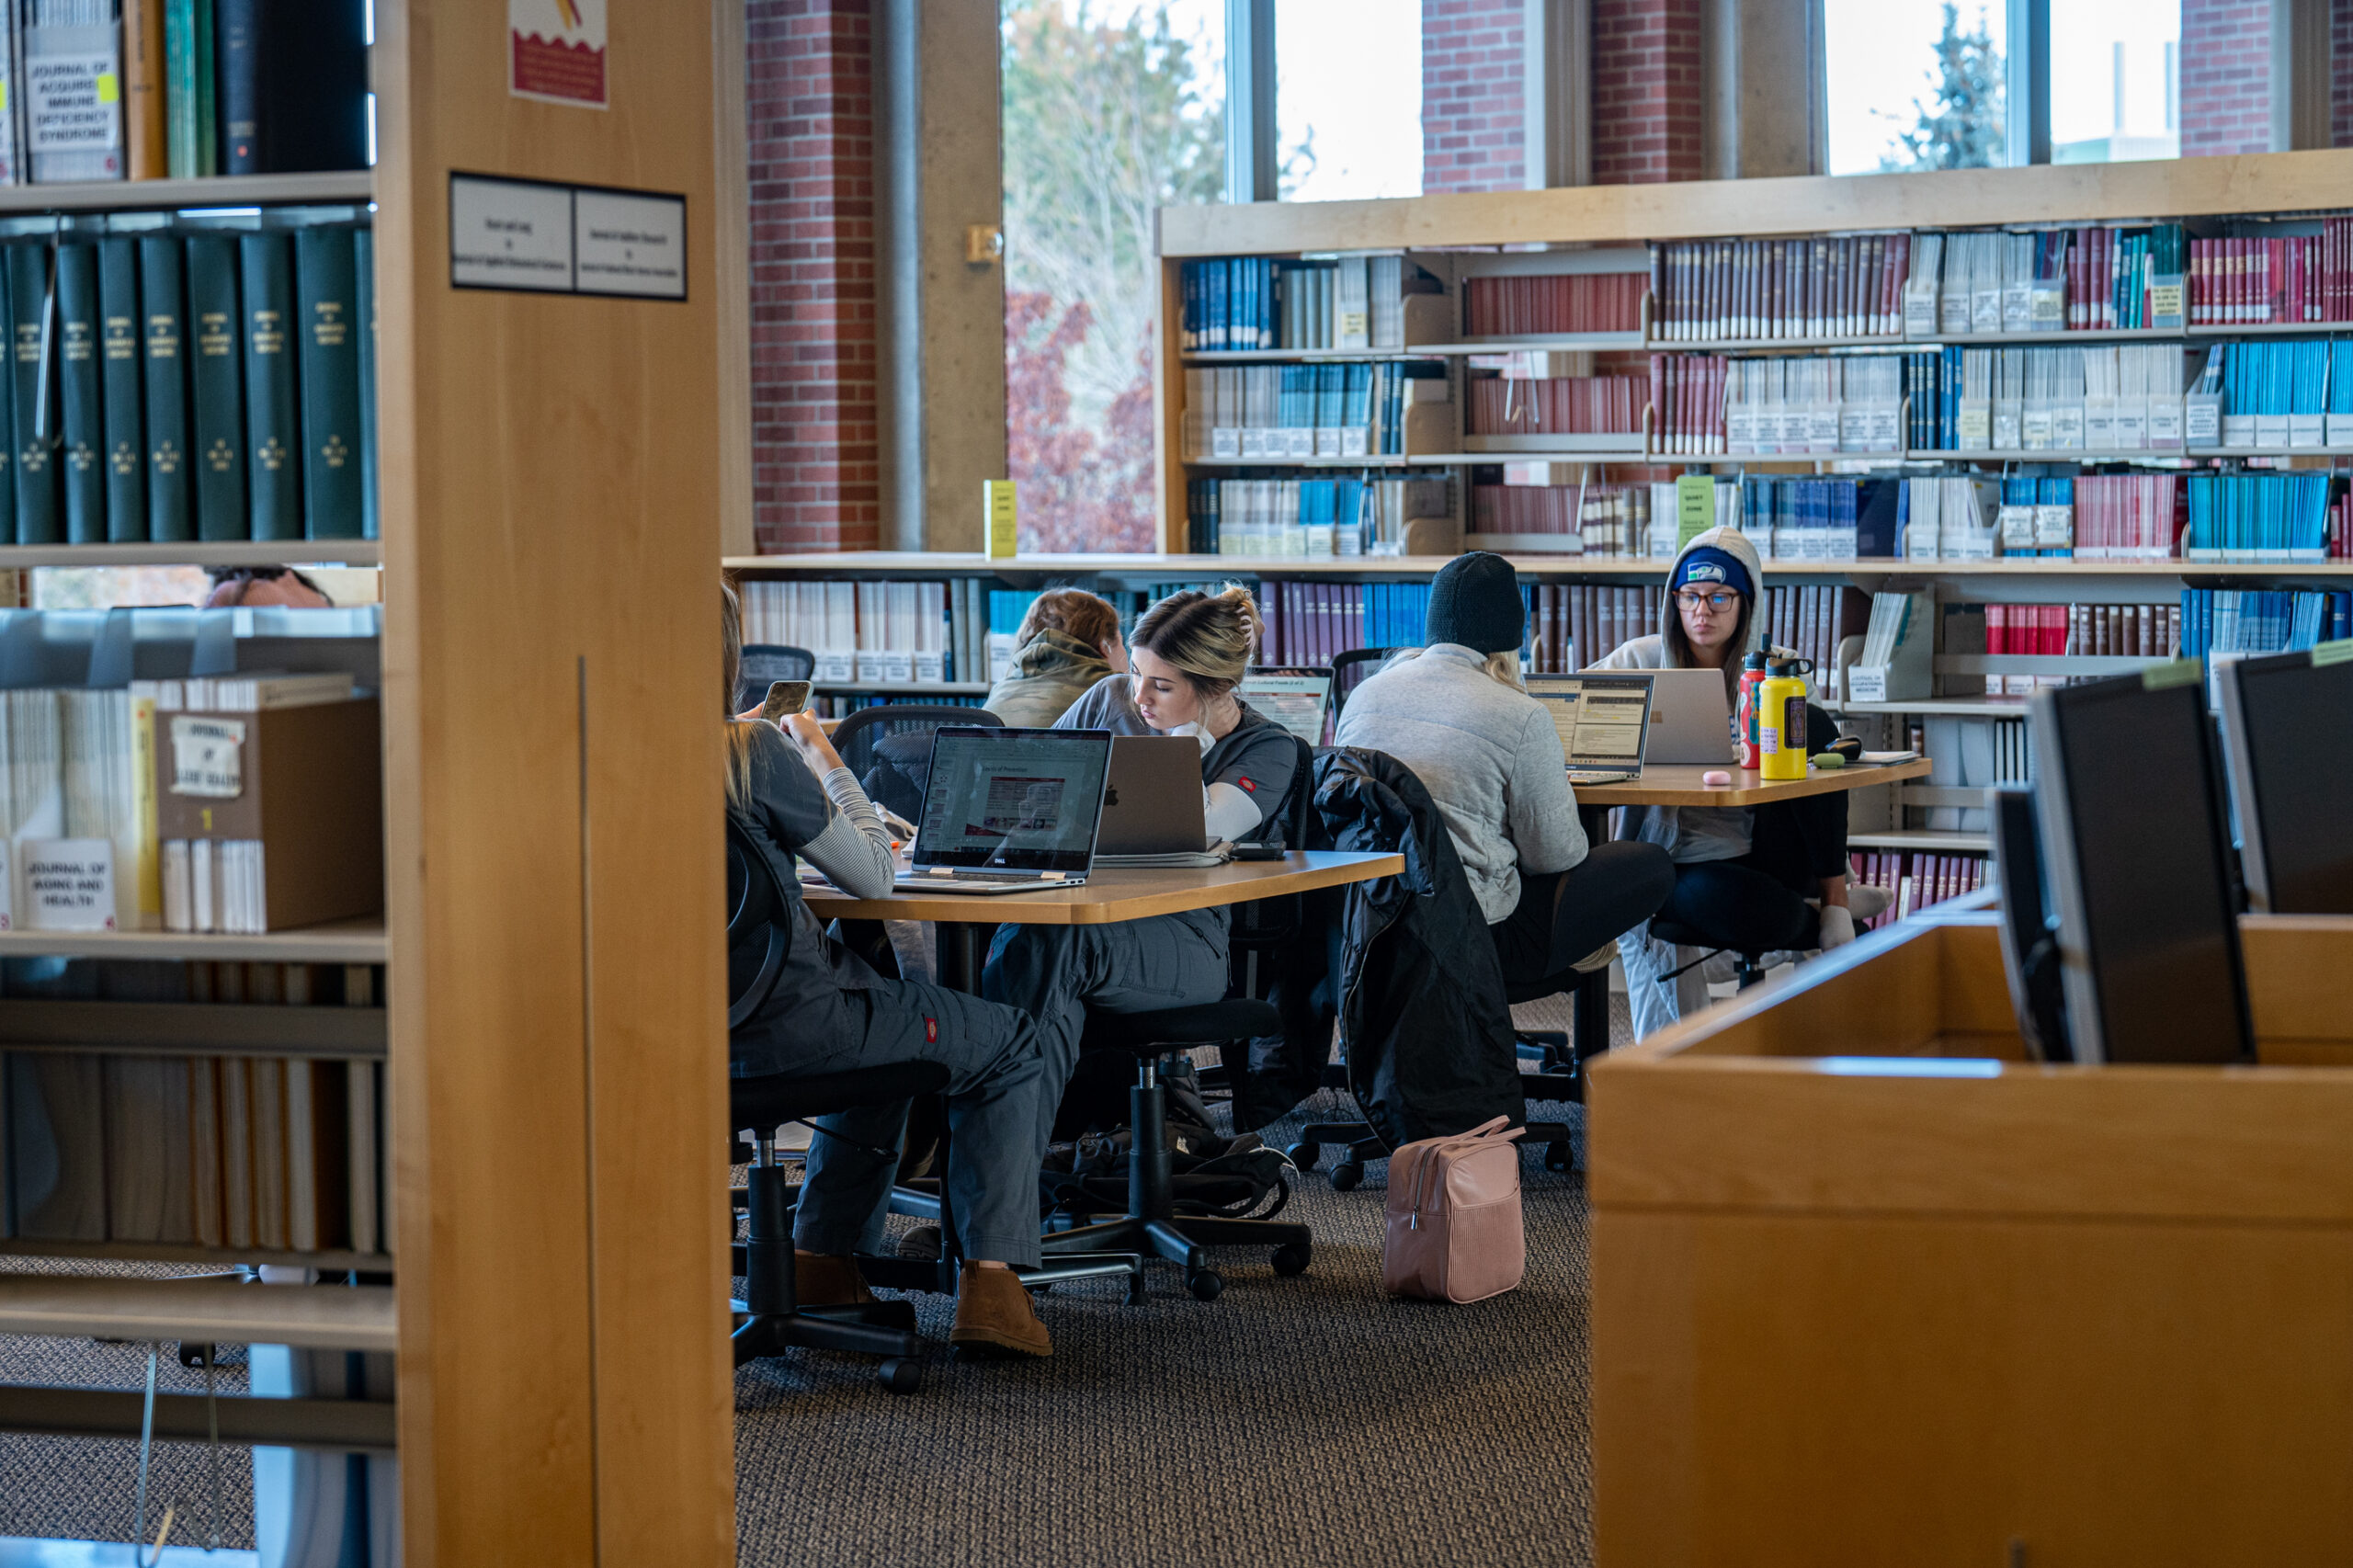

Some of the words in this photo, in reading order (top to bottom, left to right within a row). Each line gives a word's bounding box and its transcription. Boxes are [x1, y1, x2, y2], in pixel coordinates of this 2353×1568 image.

[33, 62, 87, 77] JOURNAL
[93, 61, 108, 73] OF
[40, 79, 97, 93] ACQUIRE
[48, 96, 95, 108] IMMUNE
[37, 110, 108, 125] DEFICIENCY
[40, 128, 107, 143] SYNDROME
[28, 861, 85, 874] JOURNAL
[90, 861, 106, 874] OF
[33, 879, 73, 891] AGING
[77, 879, 104, 892] AND
[44, 894, 95, 907] HEALTH
